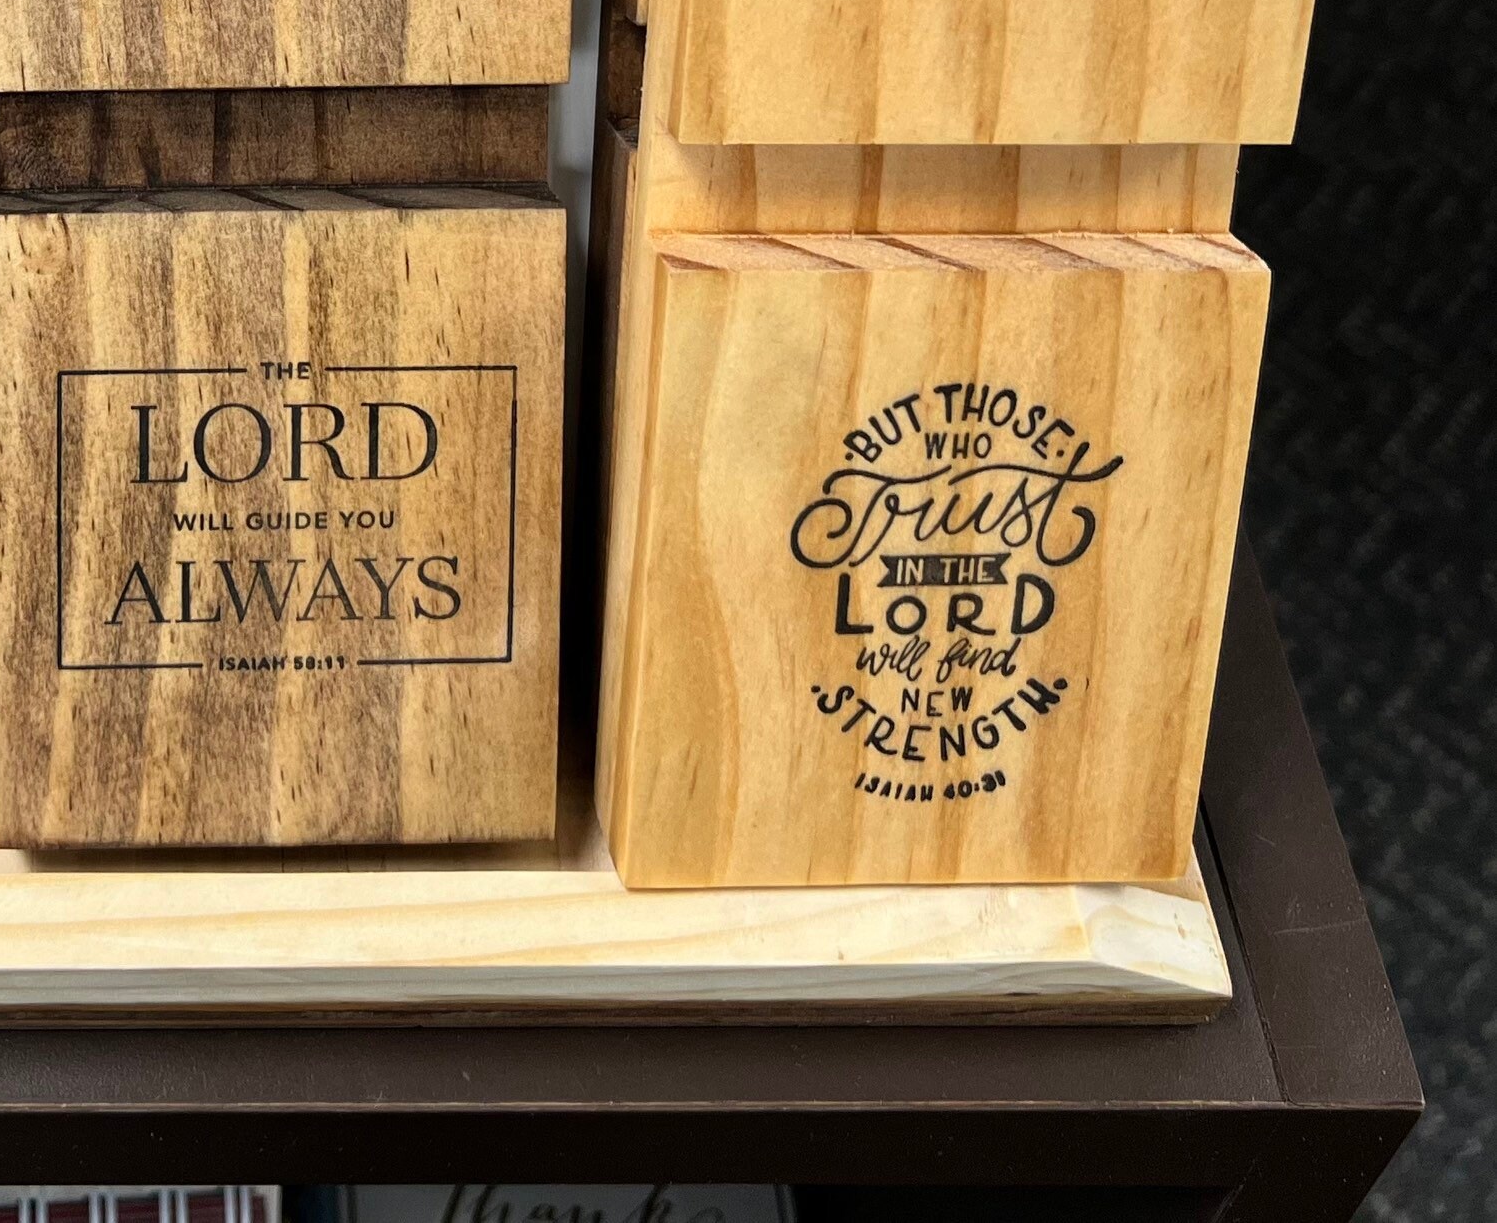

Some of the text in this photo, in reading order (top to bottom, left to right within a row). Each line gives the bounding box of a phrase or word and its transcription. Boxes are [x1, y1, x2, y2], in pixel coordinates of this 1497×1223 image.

[261, 361, 312, 380] THE
[845, 382, 1076, 463] BUT THOSE
[129, 401, 439, 485] LORD
[924, 432, 993, 460] WHO
[172, 509, 396, 533] WILL GUIDE YOU
[790, 441, 1125, 569] Trust
[103, 554, 462, 627] ALWAYS
[895, 556, 997, 585] IN THE
[835, 572, 1056, 636] LORD
[218, 655, 345, 673] ISAIAH 58:11
[856, 635, 1023, 683] will find
[816, 677, 1062, 762] STRENGTH
[900, 686, 974, 718] NEW
[855, 771, 934, 802] ISAIAH
